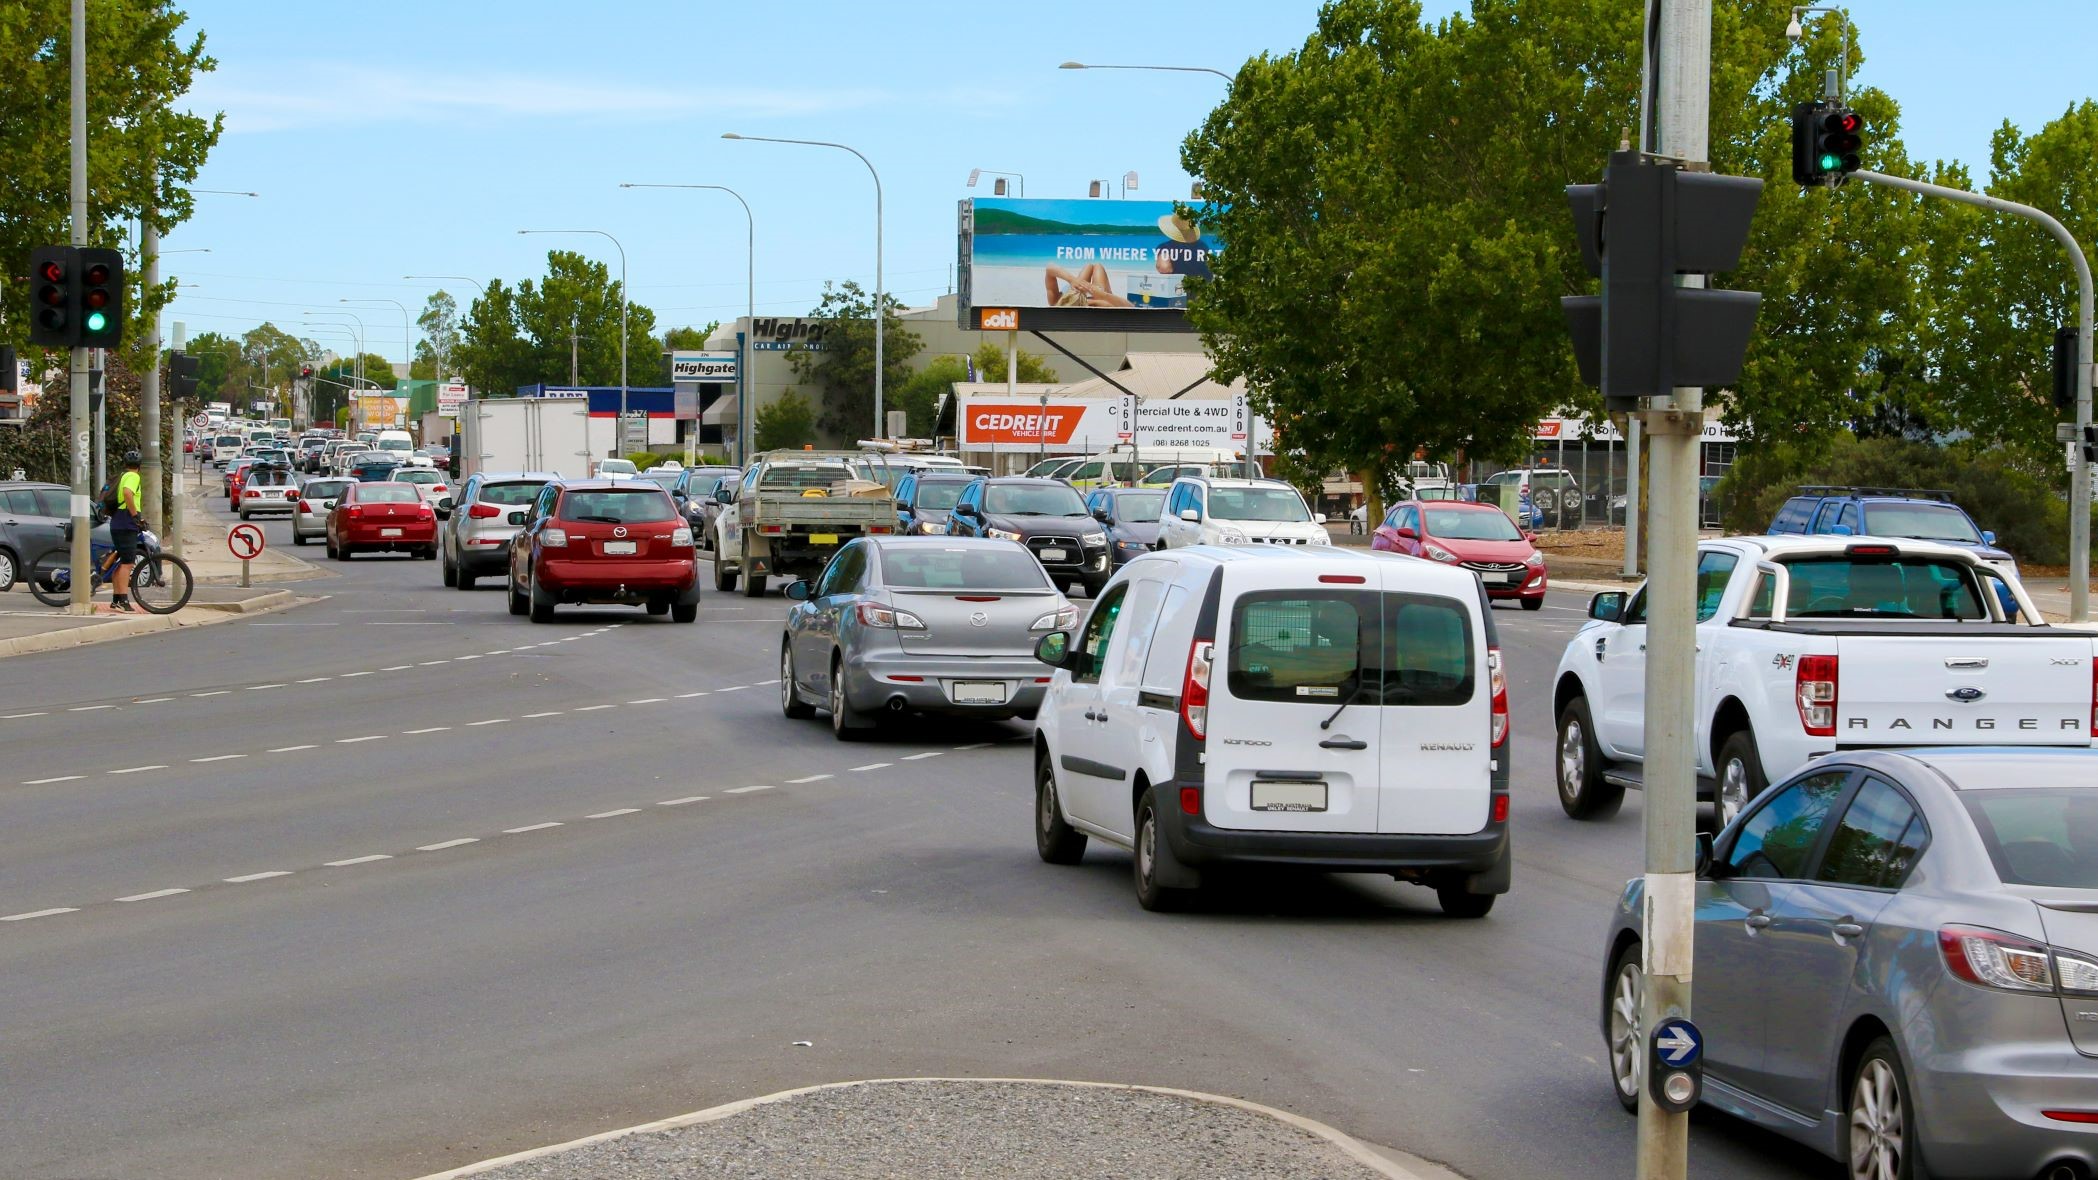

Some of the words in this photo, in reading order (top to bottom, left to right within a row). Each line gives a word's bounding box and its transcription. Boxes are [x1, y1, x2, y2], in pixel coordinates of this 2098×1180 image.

[1056, 246, 1095, 260] FROM
[1099, 247, 1148, 261] WHERE
[1152, 248, 1192, 262] YOU'D
[753, 318, 830, 342] Highg
[674, 363, 736, 375] Highgate
[1108, 406, 1170, 416] Cmercial
[1173, 407, 1191, 416] Ute
[1193, 407, 1201, 416] &
[1203, 407, 1229, 417] 4WD
[975, 414, 1064, 430] CEDRENT
[1170, 439, 1189, 447] 8268
[1192, 439, 1210, 447] 1025
[1848, 717, 2081, 730] RANGER
[1420, 743, 1476, 751] RENAULT
